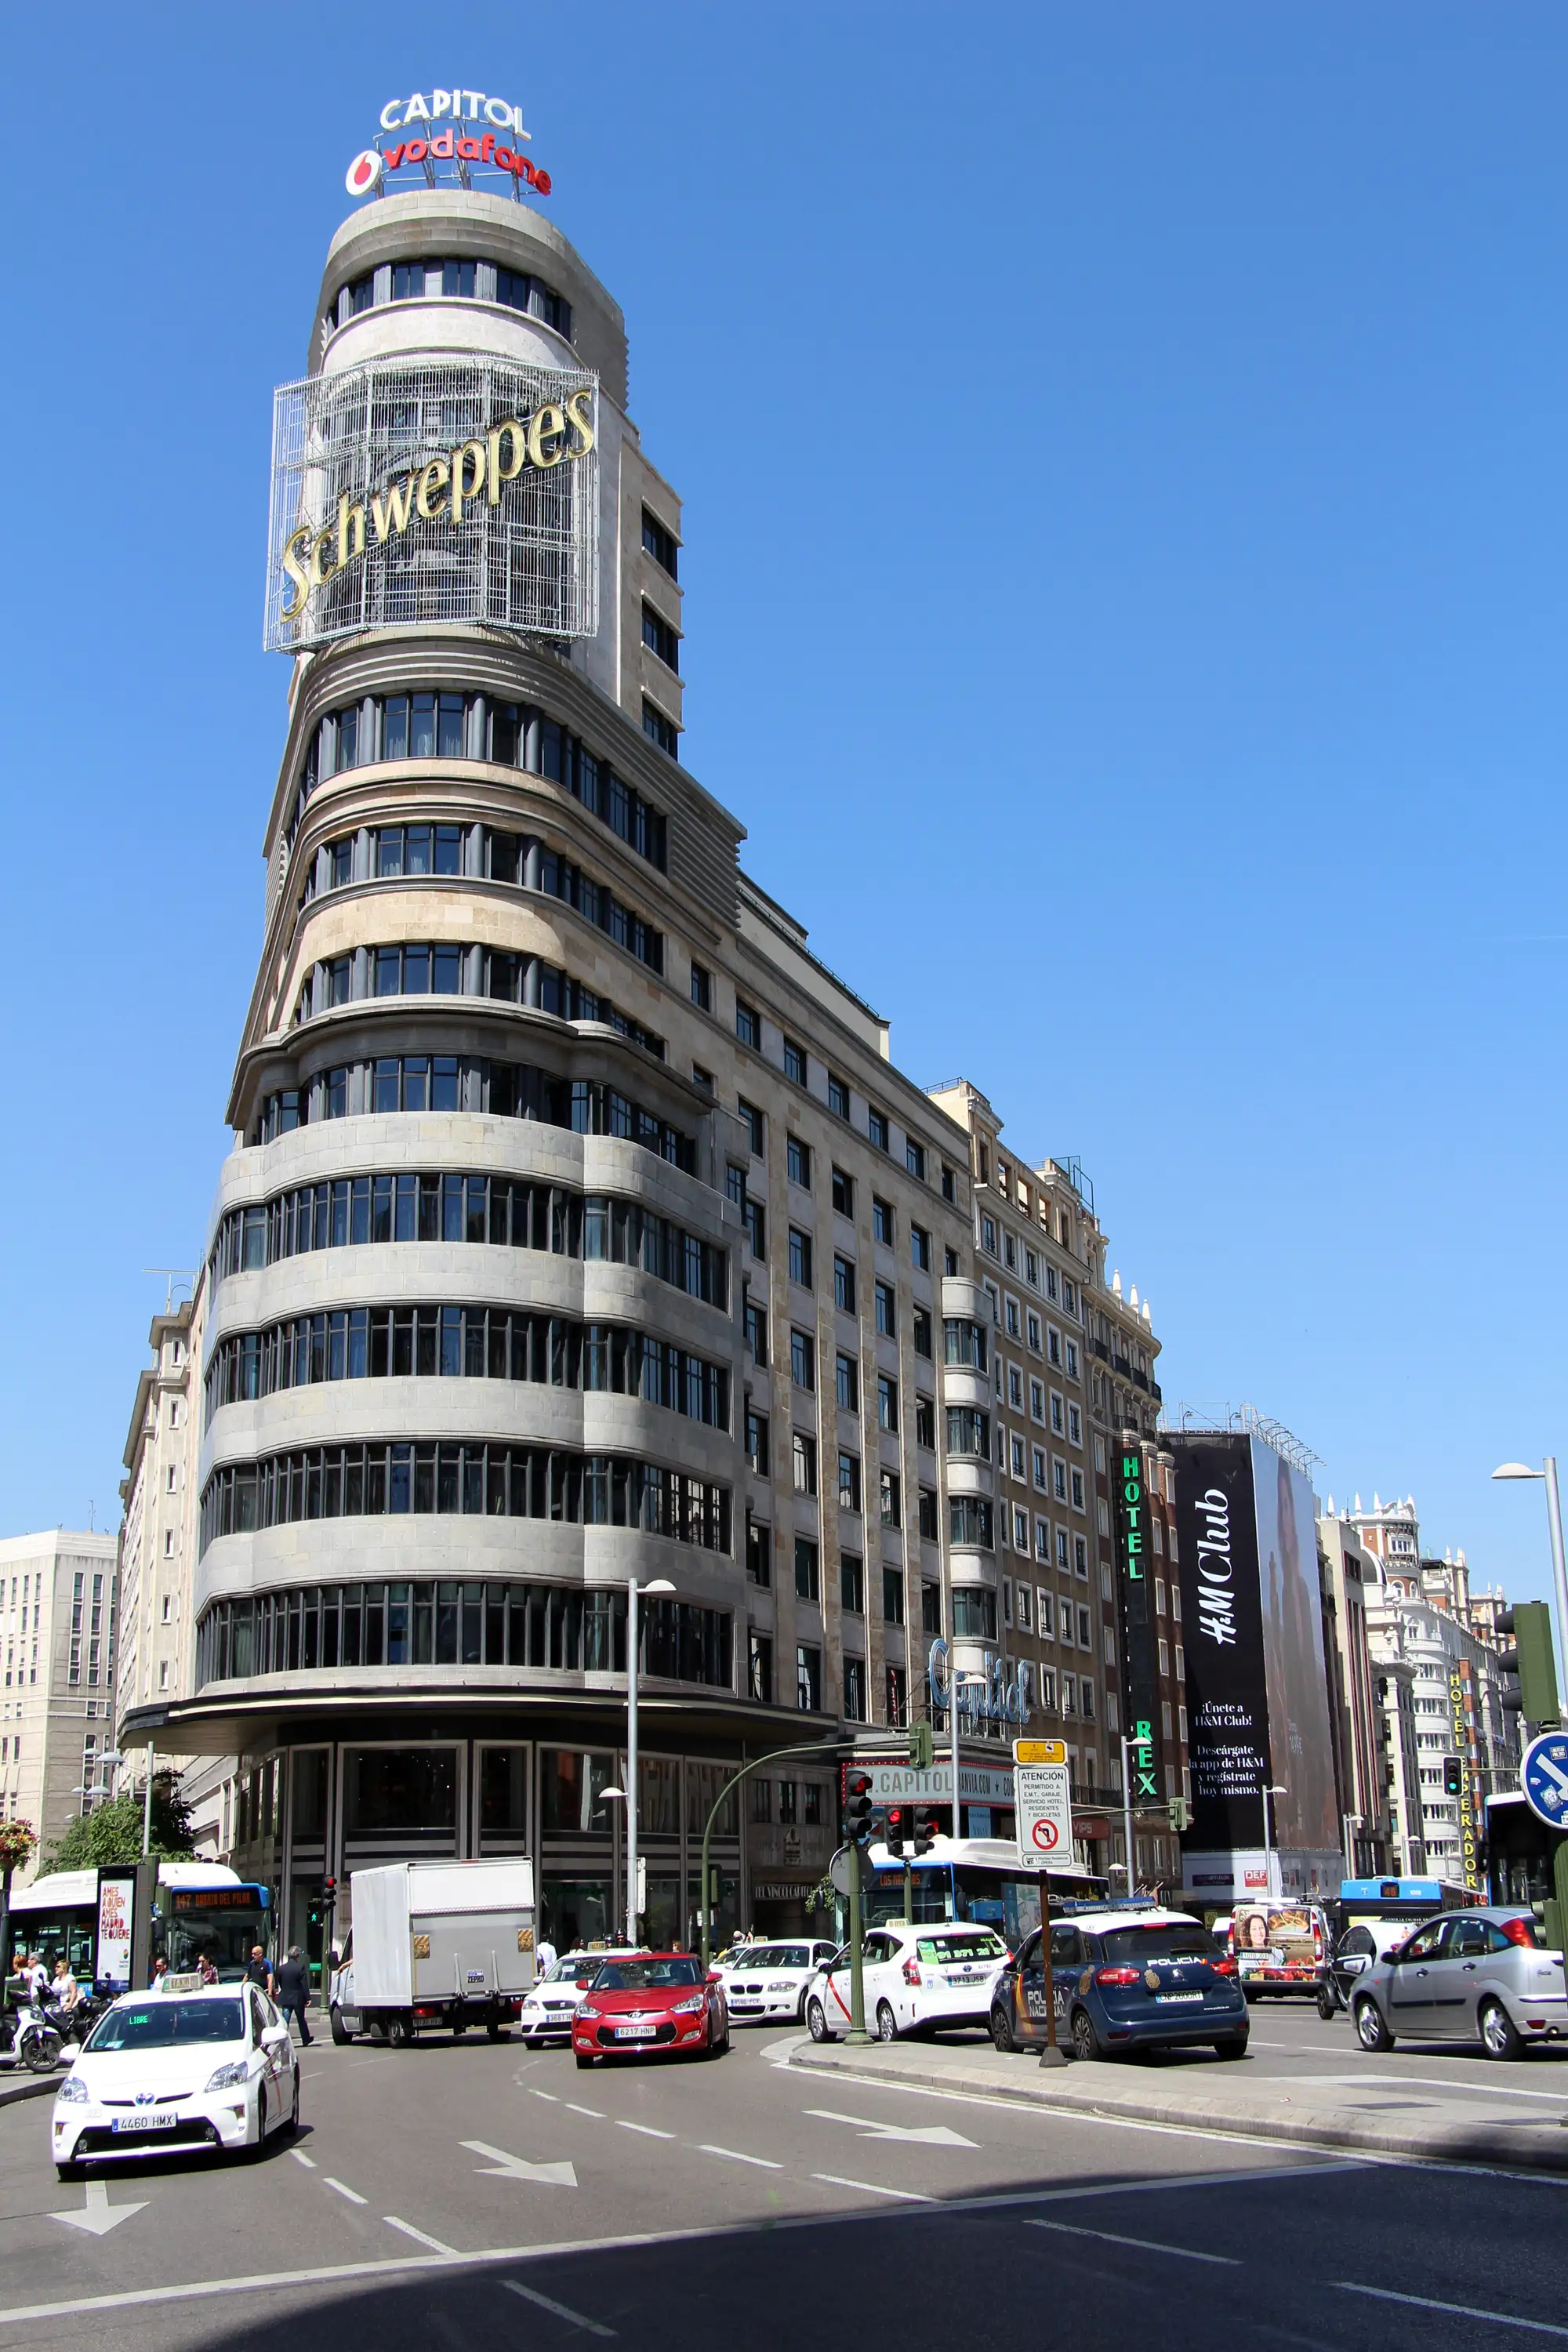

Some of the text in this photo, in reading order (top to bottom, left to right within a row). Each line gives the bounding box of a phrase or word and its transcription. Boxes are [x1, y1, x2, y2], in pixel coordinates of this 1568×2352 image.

[380, 89, 532, 141] CAPITOL
[384, 129, 552, 196] vodafone
[281, 388, 595, 623] Schweppes
[1195, 1488, 1237, 1645] H&M Club
[1123, 1456, 1158, 1796] HOTEL REX
[1450, 1675, 1465, 1748] HOTEL
[1196, 1715, 1252, 1726] H&M Club!
[1197, 1744, 1254, 1757] Descárgate
[1189, 1757, 1264, 1770] la app de H&M
[1021, 1769, 1064, 1780] ATENCIÓN
[1198, 1771, 1256, 1784] y regístrate
[1199, 1784, 1259, 1797] hoy mismo.
[1073, 1821, 1093, 1835] VIPS
[880, 1875, 891, 1886] LOS
[103, 1886, 118, 1897] AMES
[102, 1897, 125, 1907] A QUIEN
[101, 1918, 124, 1929] MADRID
[101, 1929, 130, 1940] TE QUIERE
[937, 1951, 952, 1959] 91
[1147, 1956, 1202, 1967] POLICÍA
[172, 1977, 190, 1988] TAXI
[953, 1976, 971, 1984] 3713
[1160, 1992, 1174, 2002] CNP
[129, 2015, 148, 2025] LIBRE
[620, 2027, 655, 2036] 6217 HNP
[122, 2115, 172, 2129] 4460 HMX
